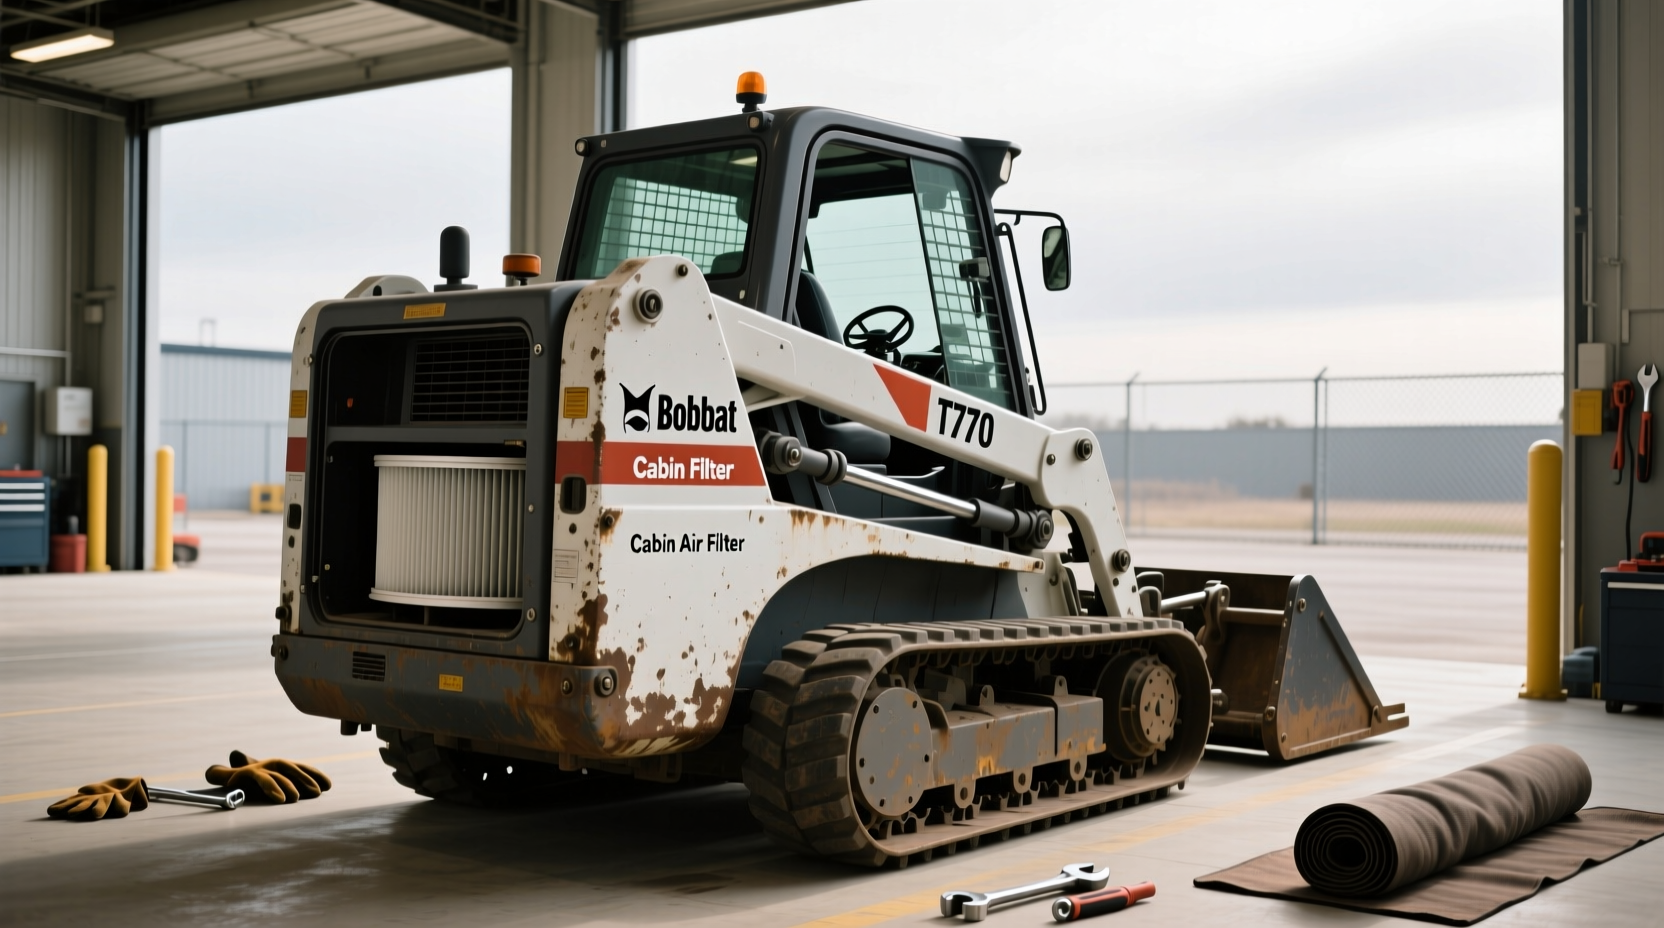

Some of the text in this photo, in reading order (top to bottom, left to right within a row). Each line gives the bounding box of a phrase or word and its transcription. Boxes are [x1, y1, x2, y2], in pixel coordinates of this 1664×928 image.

[656, 394, 738, 433] Bobbat
[937, 397, 995, 449] T770
[632, 455, 686, 480] Cabin
[630, 532, 676, 554] Cabin
[679, 532, 704, 553] Air
